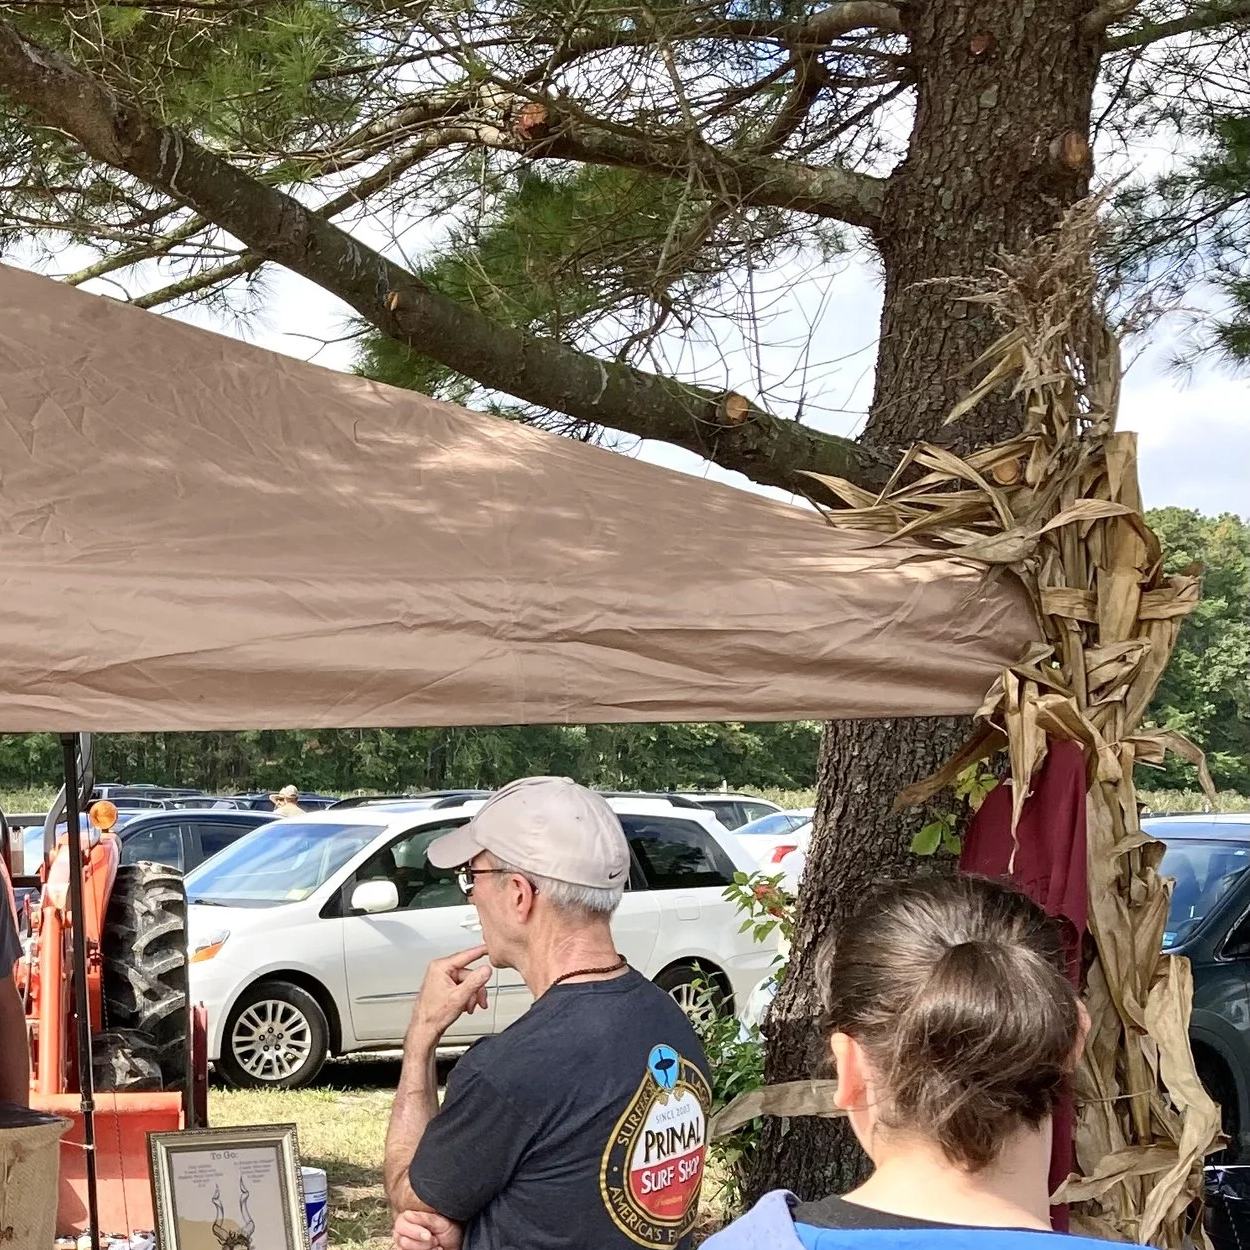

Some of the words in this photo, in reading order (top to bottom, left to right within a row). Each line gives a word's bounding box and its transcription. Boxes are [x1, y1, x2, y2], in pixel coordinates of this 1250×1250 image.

[655, 1110, 675, 1124] SINCE
[211, 1152, 223, 1161] To
[644, 1116, 702, 1163] PRIMAL
[640, 1165, 676, 1195] SURF
[677, 1155, 700, 1183] SHOP
[609, 1186, 663, 1242] AMERICA'S
